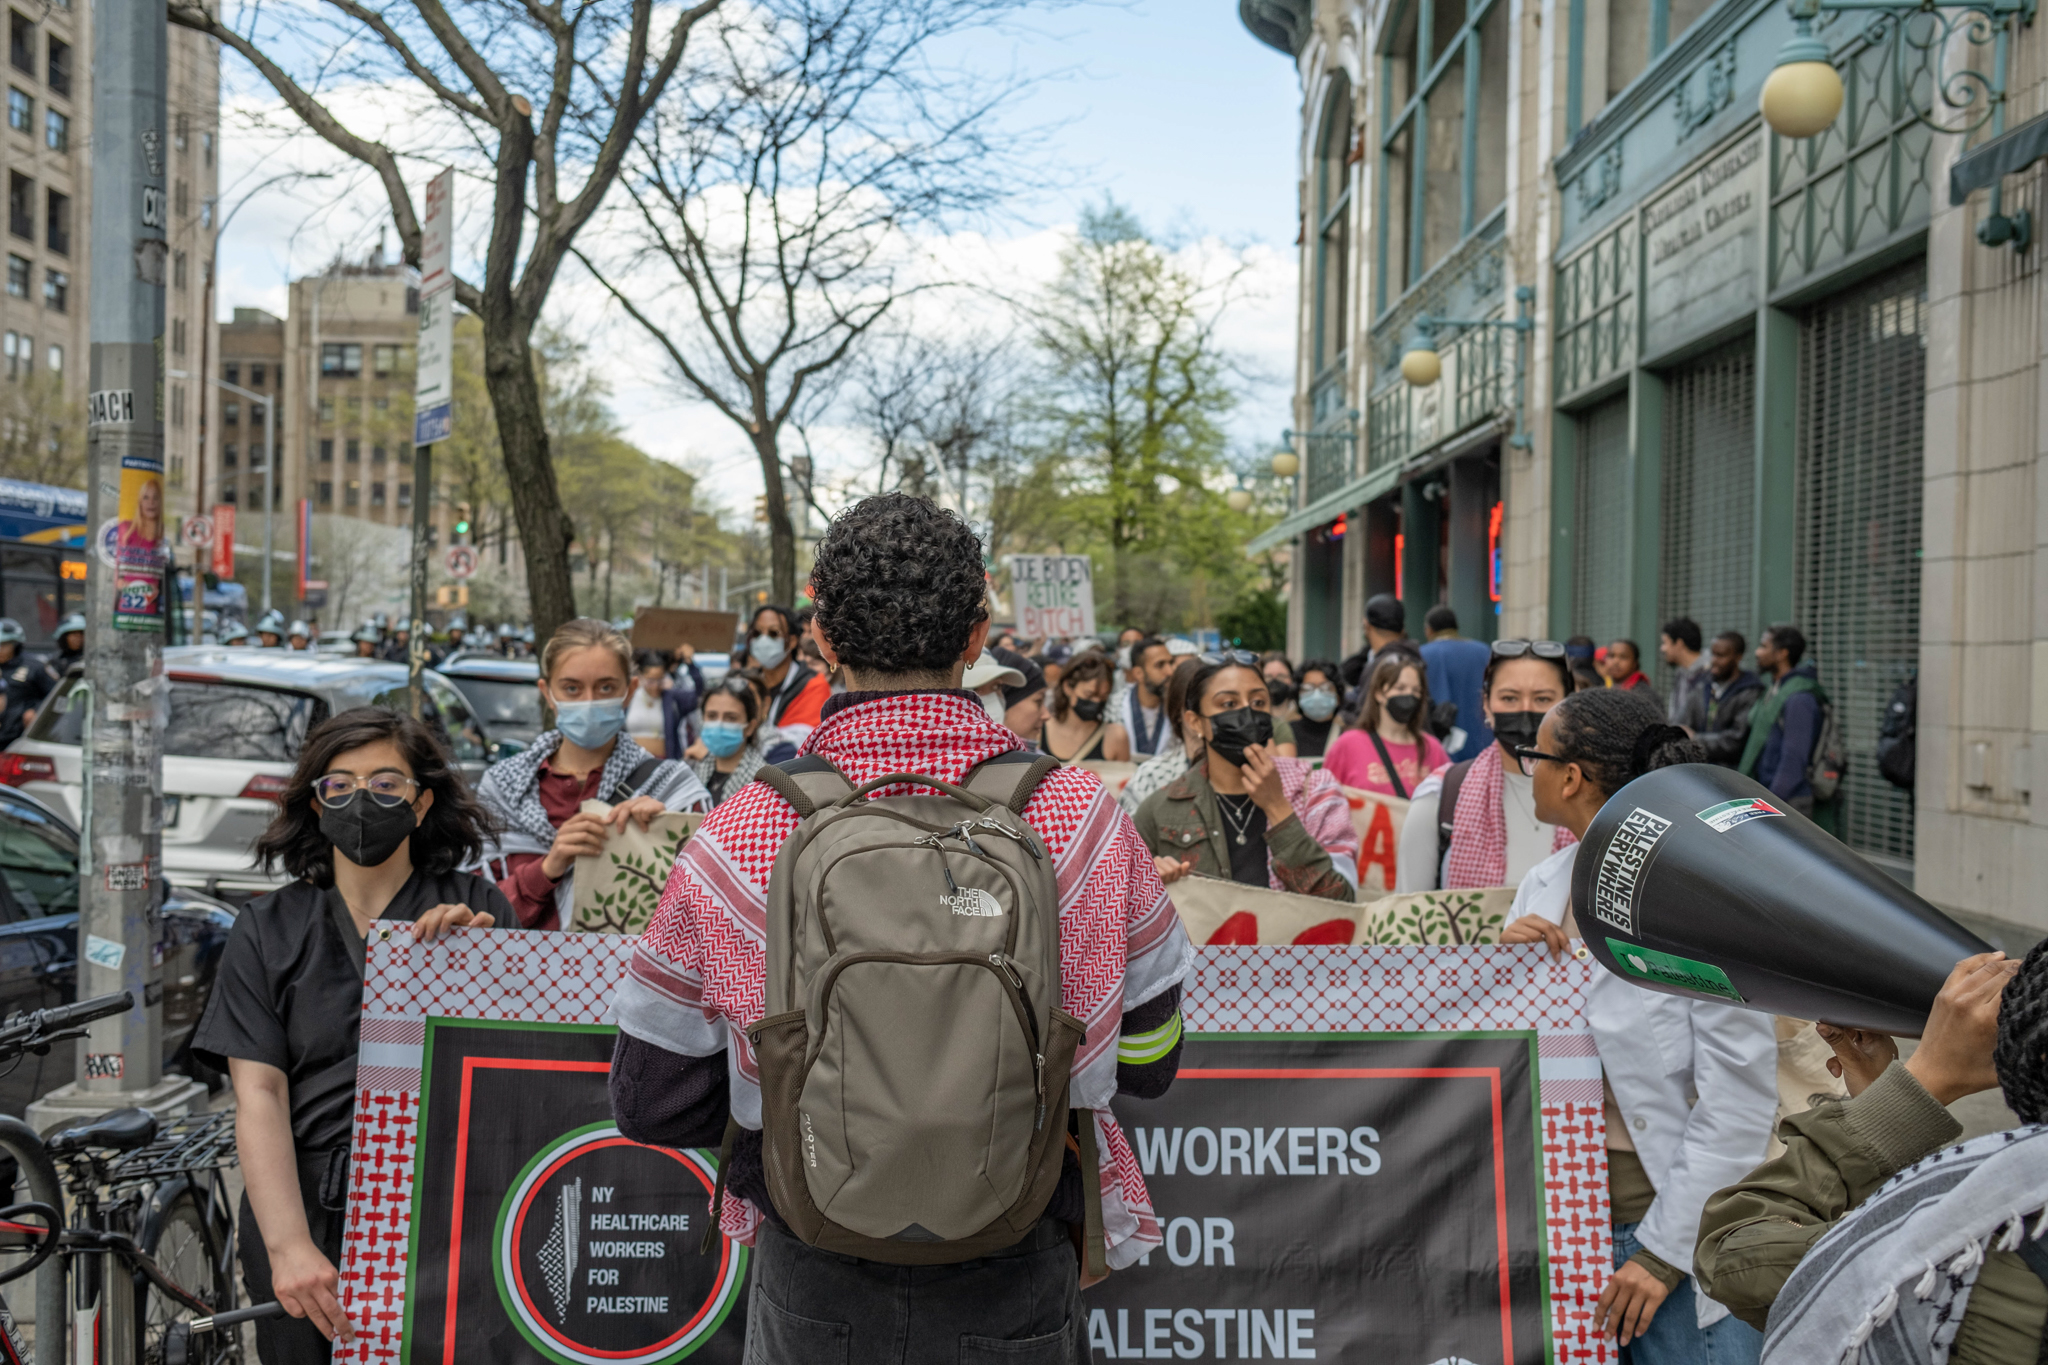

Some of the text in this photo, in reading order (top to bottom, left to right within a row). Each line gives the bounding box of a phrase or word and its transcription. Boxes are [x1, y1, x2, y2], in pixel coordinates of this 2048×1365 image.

[122, 594, 146, 608] 32
[1024, 607, 1085, 636] BITCH
[1597, 810, 1651, 922] EVERYWHERE
[1613, 818, 1669, 930] PALESTINE IS
[939, 894, 979, 907] NORTH
[957, 886, 979, 899] THE
[952, 905, 981, 917] FACE
[1620, 952, 1634, 969] I
[1135, 1126, 1382, 1176] WORKERS
[591, 1186, 614, 1203] NY
[590, 1213, 689, 1231] HEALTHCARE
[590, 1241, 665, 1258] WORKERS
[588, 1269, 619, 1285] FOR
[586, 1296, 669, 1313] PALESTINE
[1088, 1308, 1316, 1360] ALESTINE
